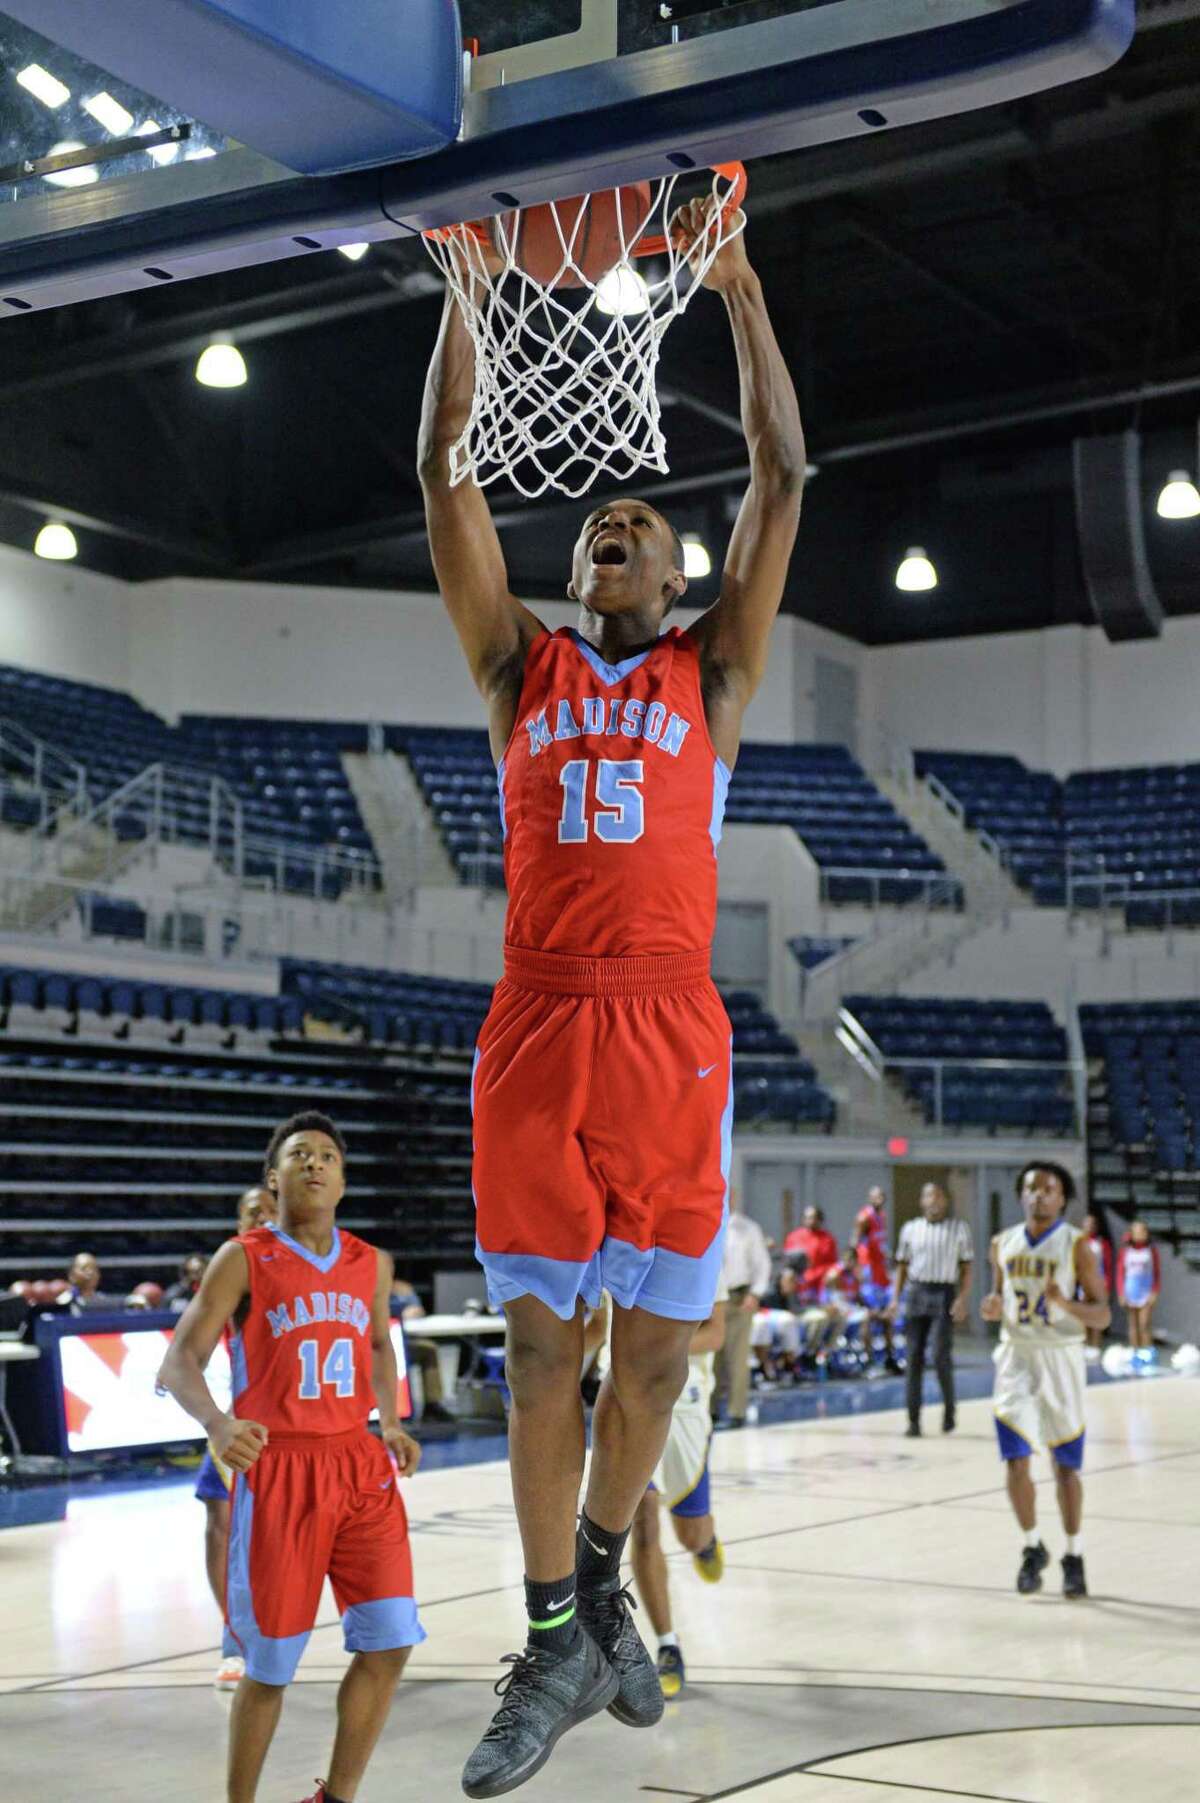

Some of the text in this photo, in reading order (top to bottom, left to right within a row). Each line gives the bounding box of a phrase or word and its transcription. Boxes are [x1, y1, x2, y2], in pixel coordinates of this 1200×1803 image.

[526, 697, 691, 757] MADISON
[558, 759, 644, 843] 15
[1013, 1289, 1051, 1326] 24
[298, 1338, 355, 1399] 14
